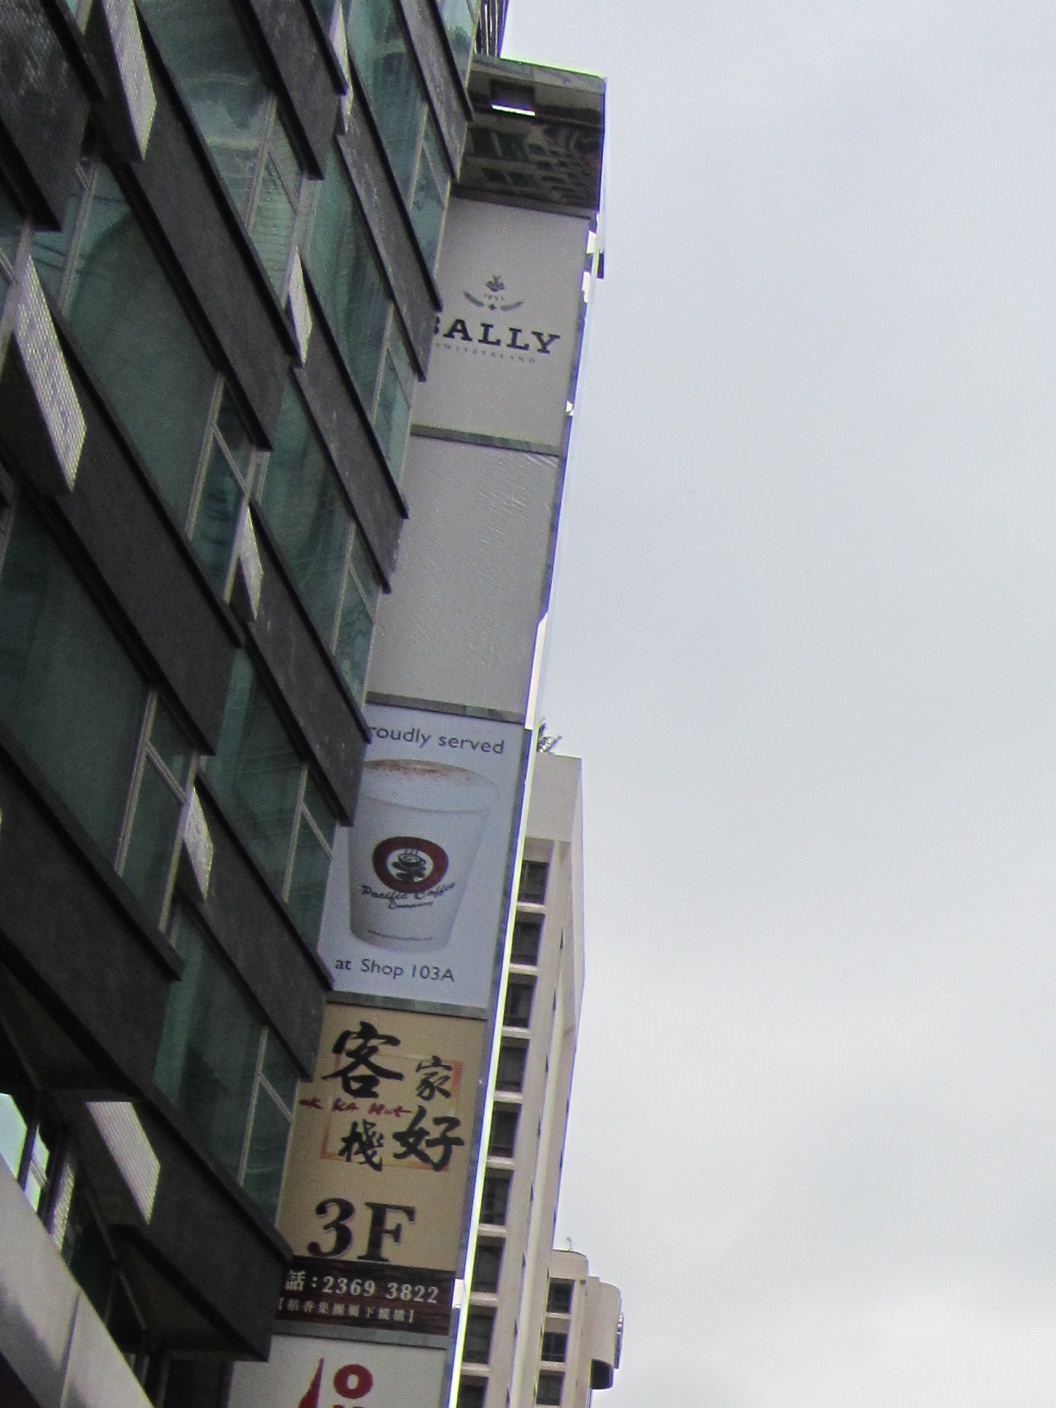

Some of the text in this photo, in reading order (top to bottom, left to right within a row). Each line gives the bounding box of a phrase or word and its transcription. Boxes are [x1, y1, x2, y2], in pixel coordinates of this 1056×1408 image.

[370, 726, 505, 755] roudly served
[361, 882, 456, 903] Pacific Coffee
[334, 958, 455, 983] at Shop 103A
[298, 1096, 323, 1110] ak
[307, 1197, 416, 1264] 3F
[386, 1281, 440, 1304] 3822
